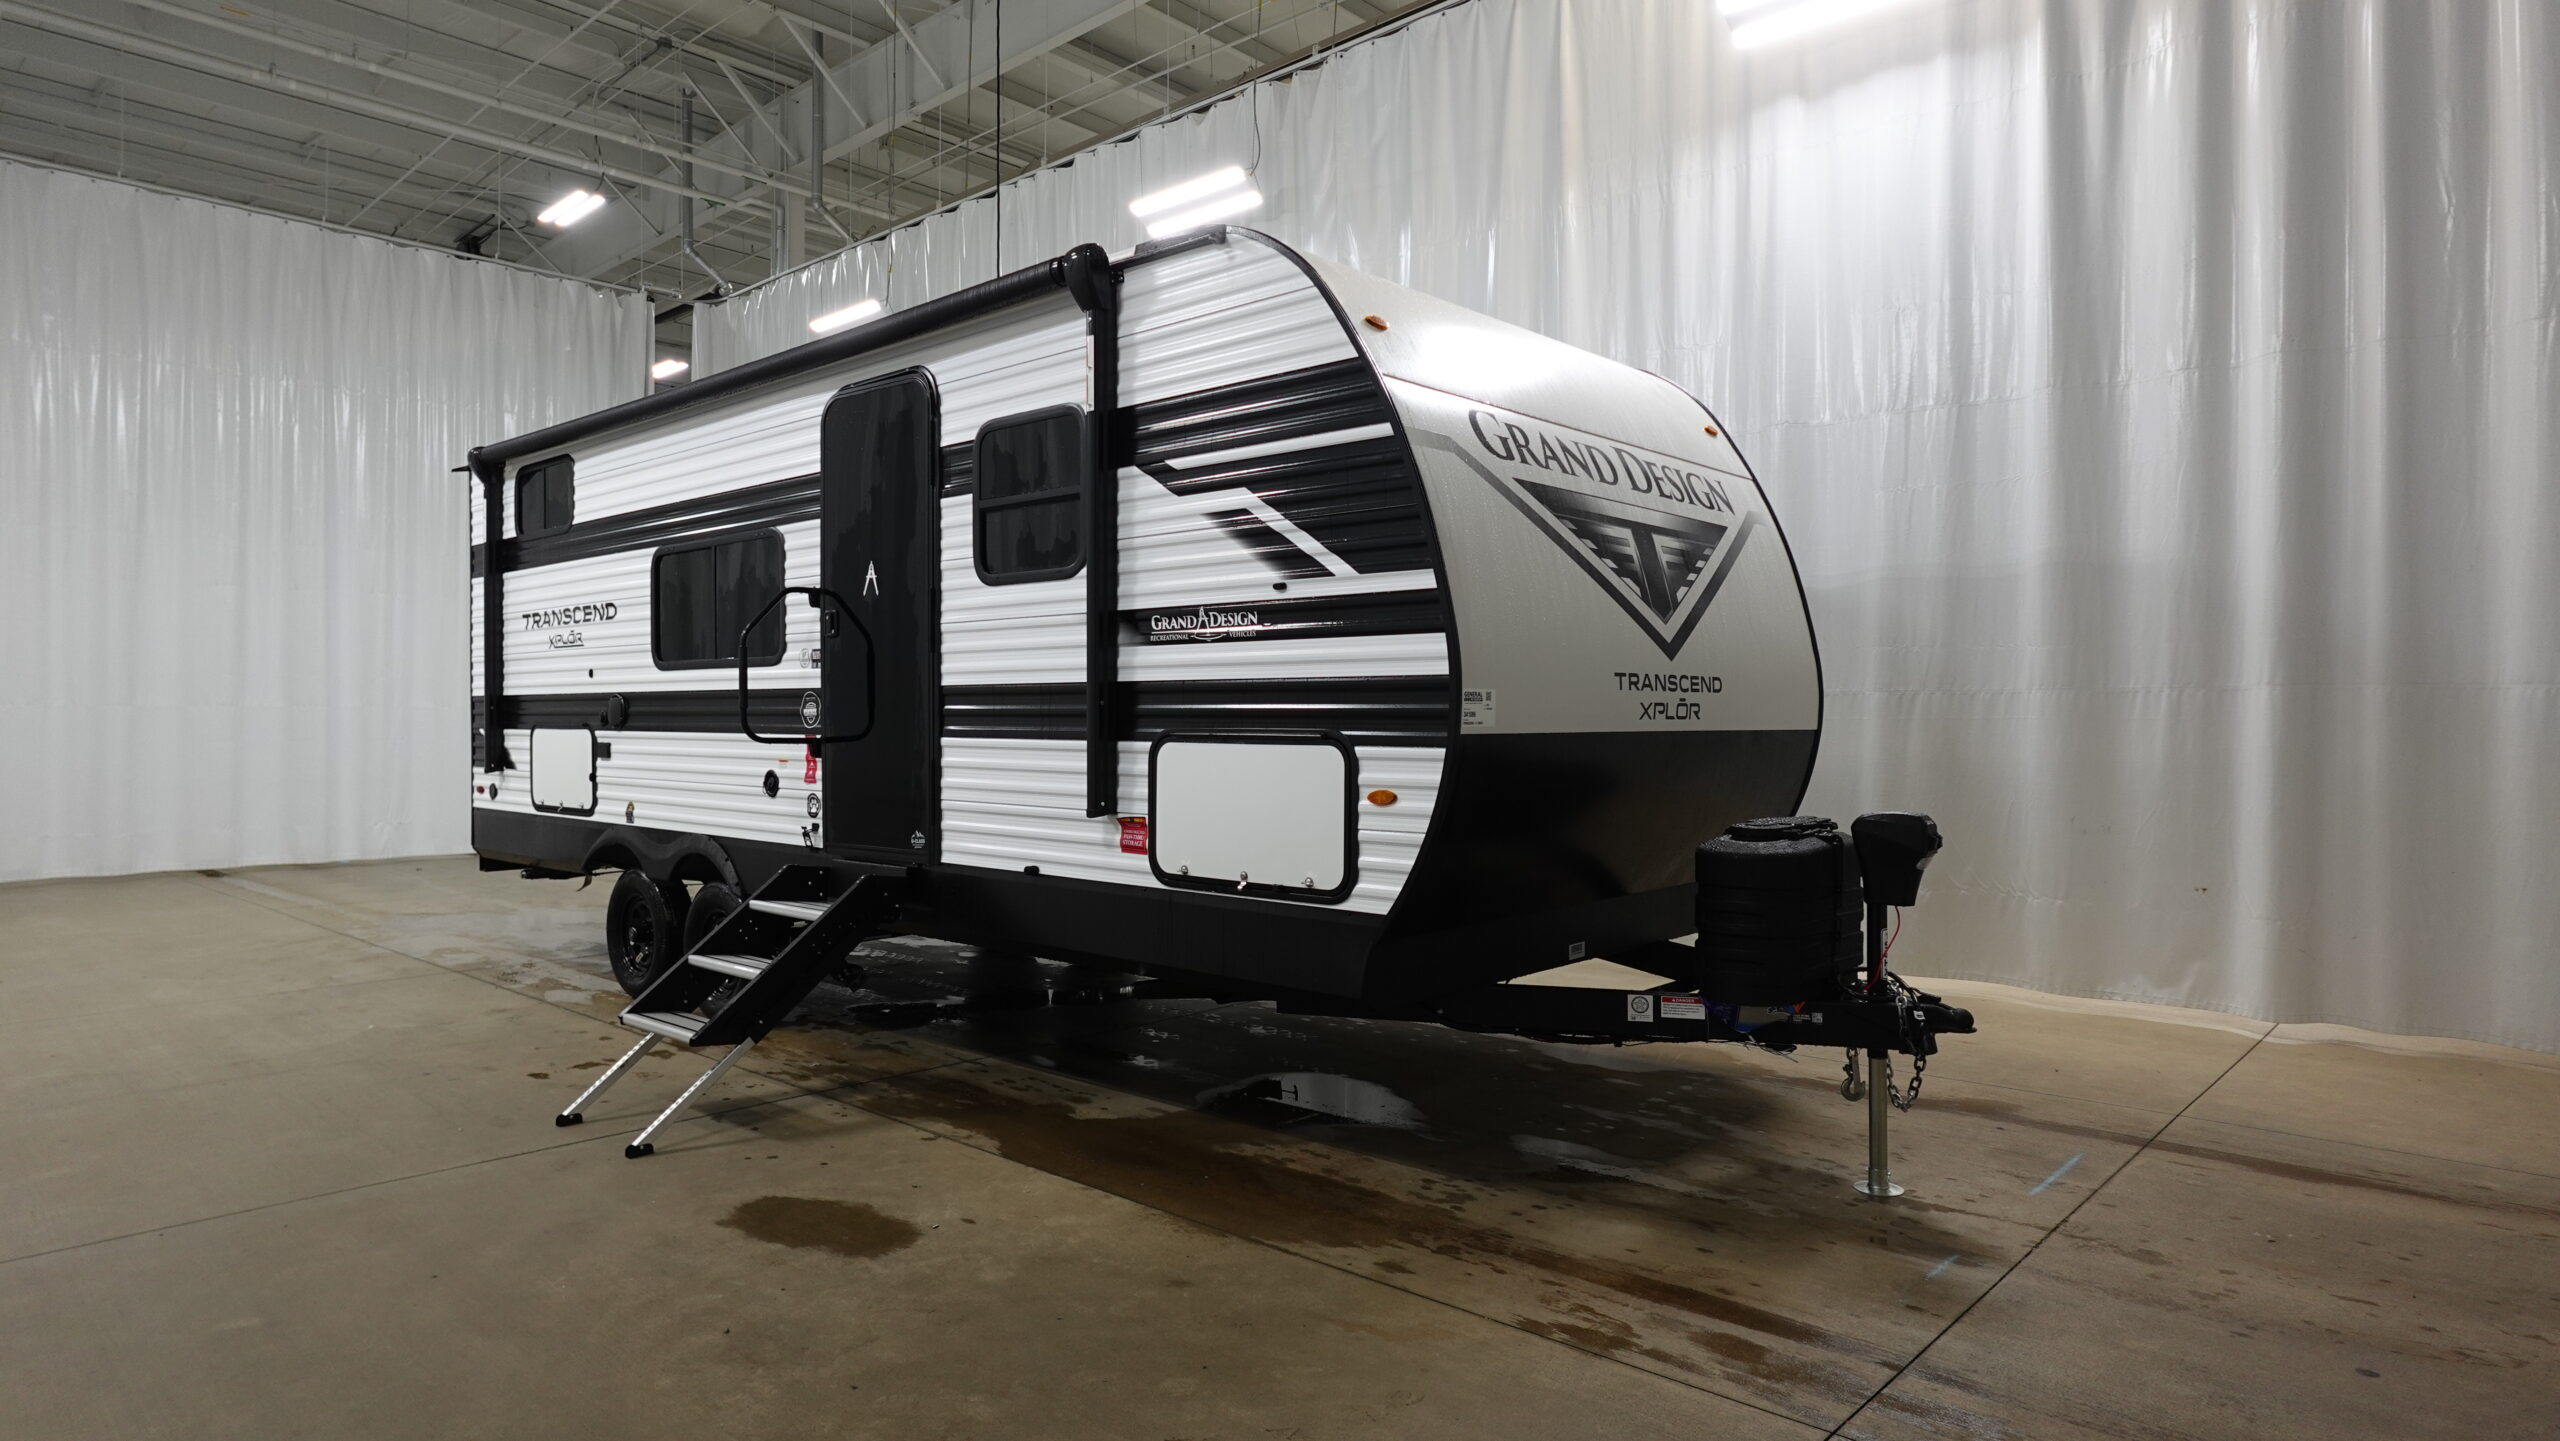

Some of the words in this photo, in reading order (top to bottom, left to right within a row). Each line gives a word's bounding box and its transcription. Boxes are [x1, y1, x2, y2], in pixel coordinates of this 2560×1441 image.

[1468, 409, 1618, 486] GRAND
[1609, 446, 1736, 516] DESIGN
[522, 602, 618, 630] TRANSCEND
[1151, 615, 1197, 631] GRAND
[1208, 611, 1258, 627] DESIGN
[1150, 634, 1189, 642] RECREATIONAL
[1229, 630, 1256, 638] VEHICLES
[1614, 672, 1722, 693] TRANSCEND
